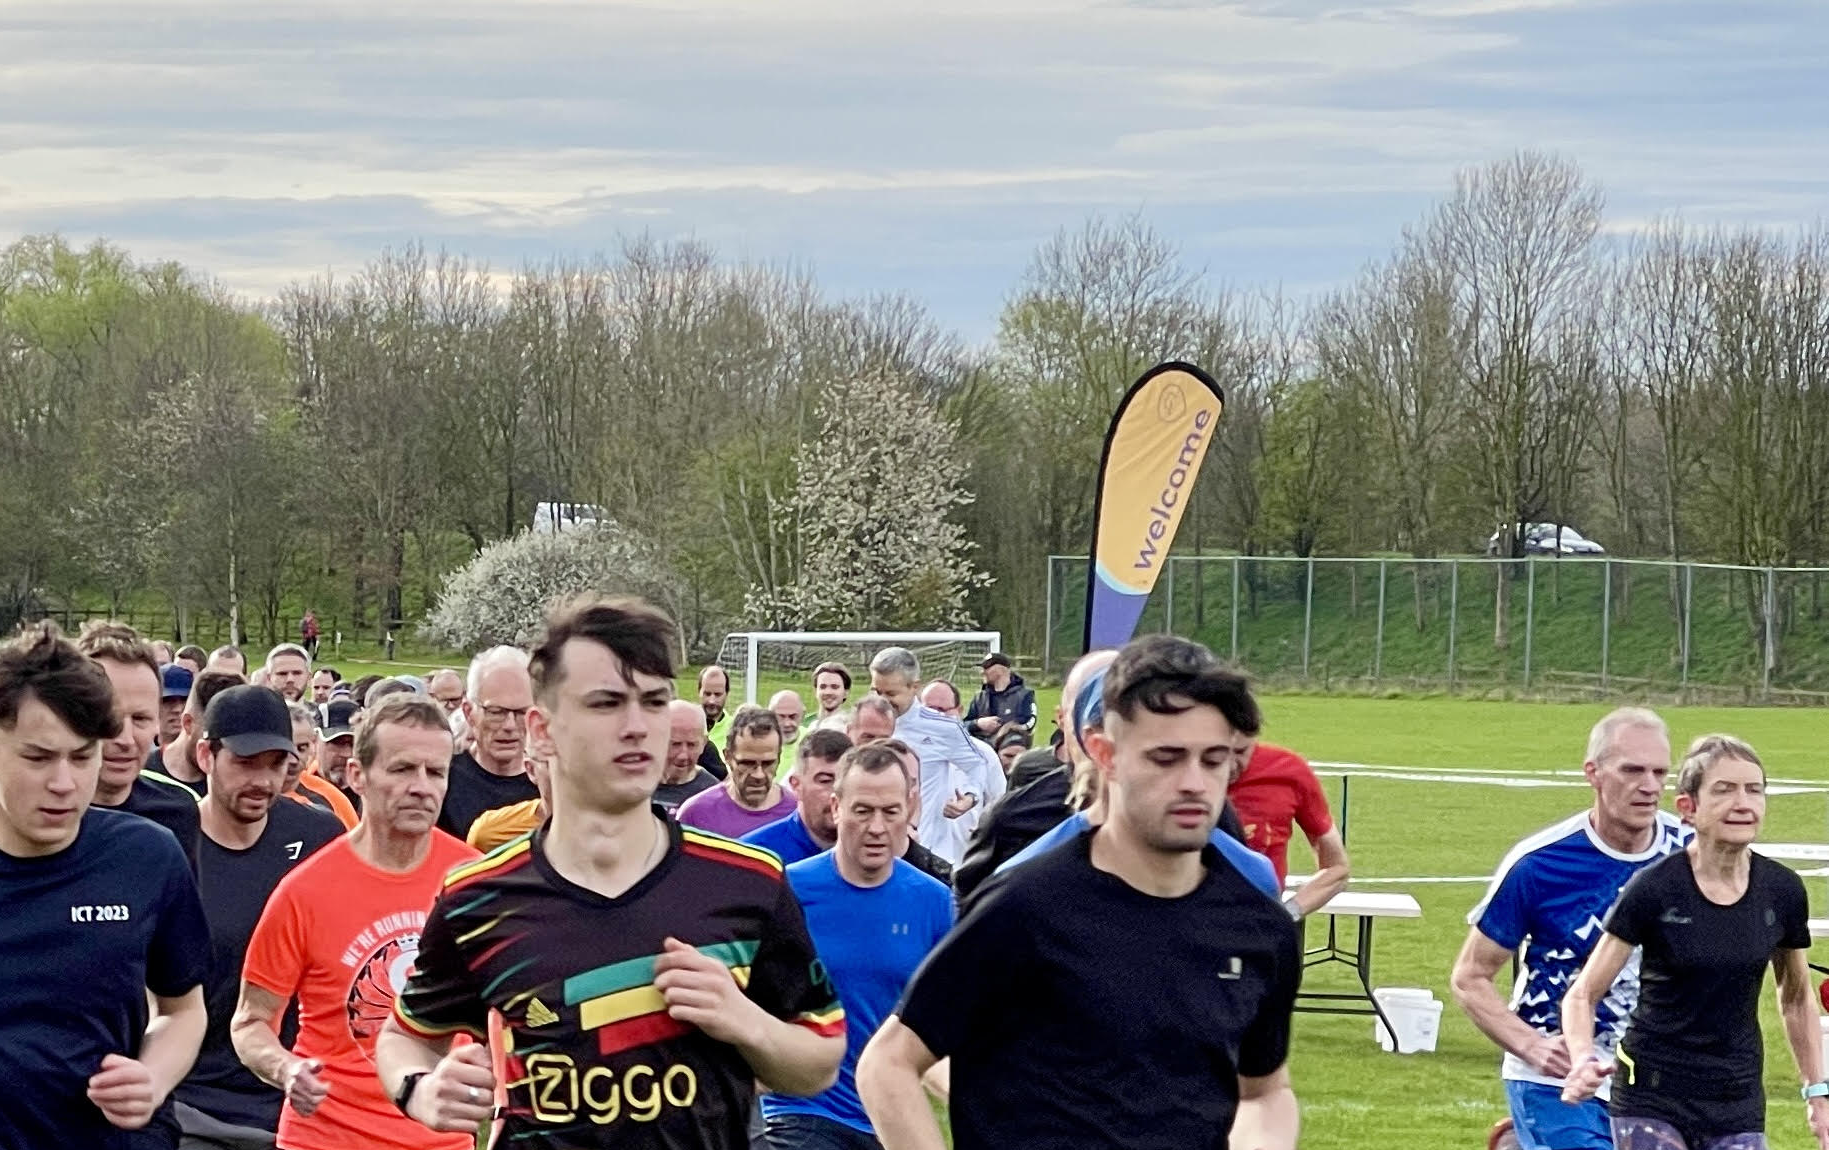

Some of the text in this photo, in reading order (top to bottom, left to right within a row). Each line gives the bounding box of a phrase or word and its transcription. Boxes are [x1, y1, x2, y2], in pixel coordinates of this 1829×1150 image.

[1134, 408, 1212, 569] welcome
[71, 904, 130, 922] ICT 2023
[372, 910, 428, 938] RUNNIN
